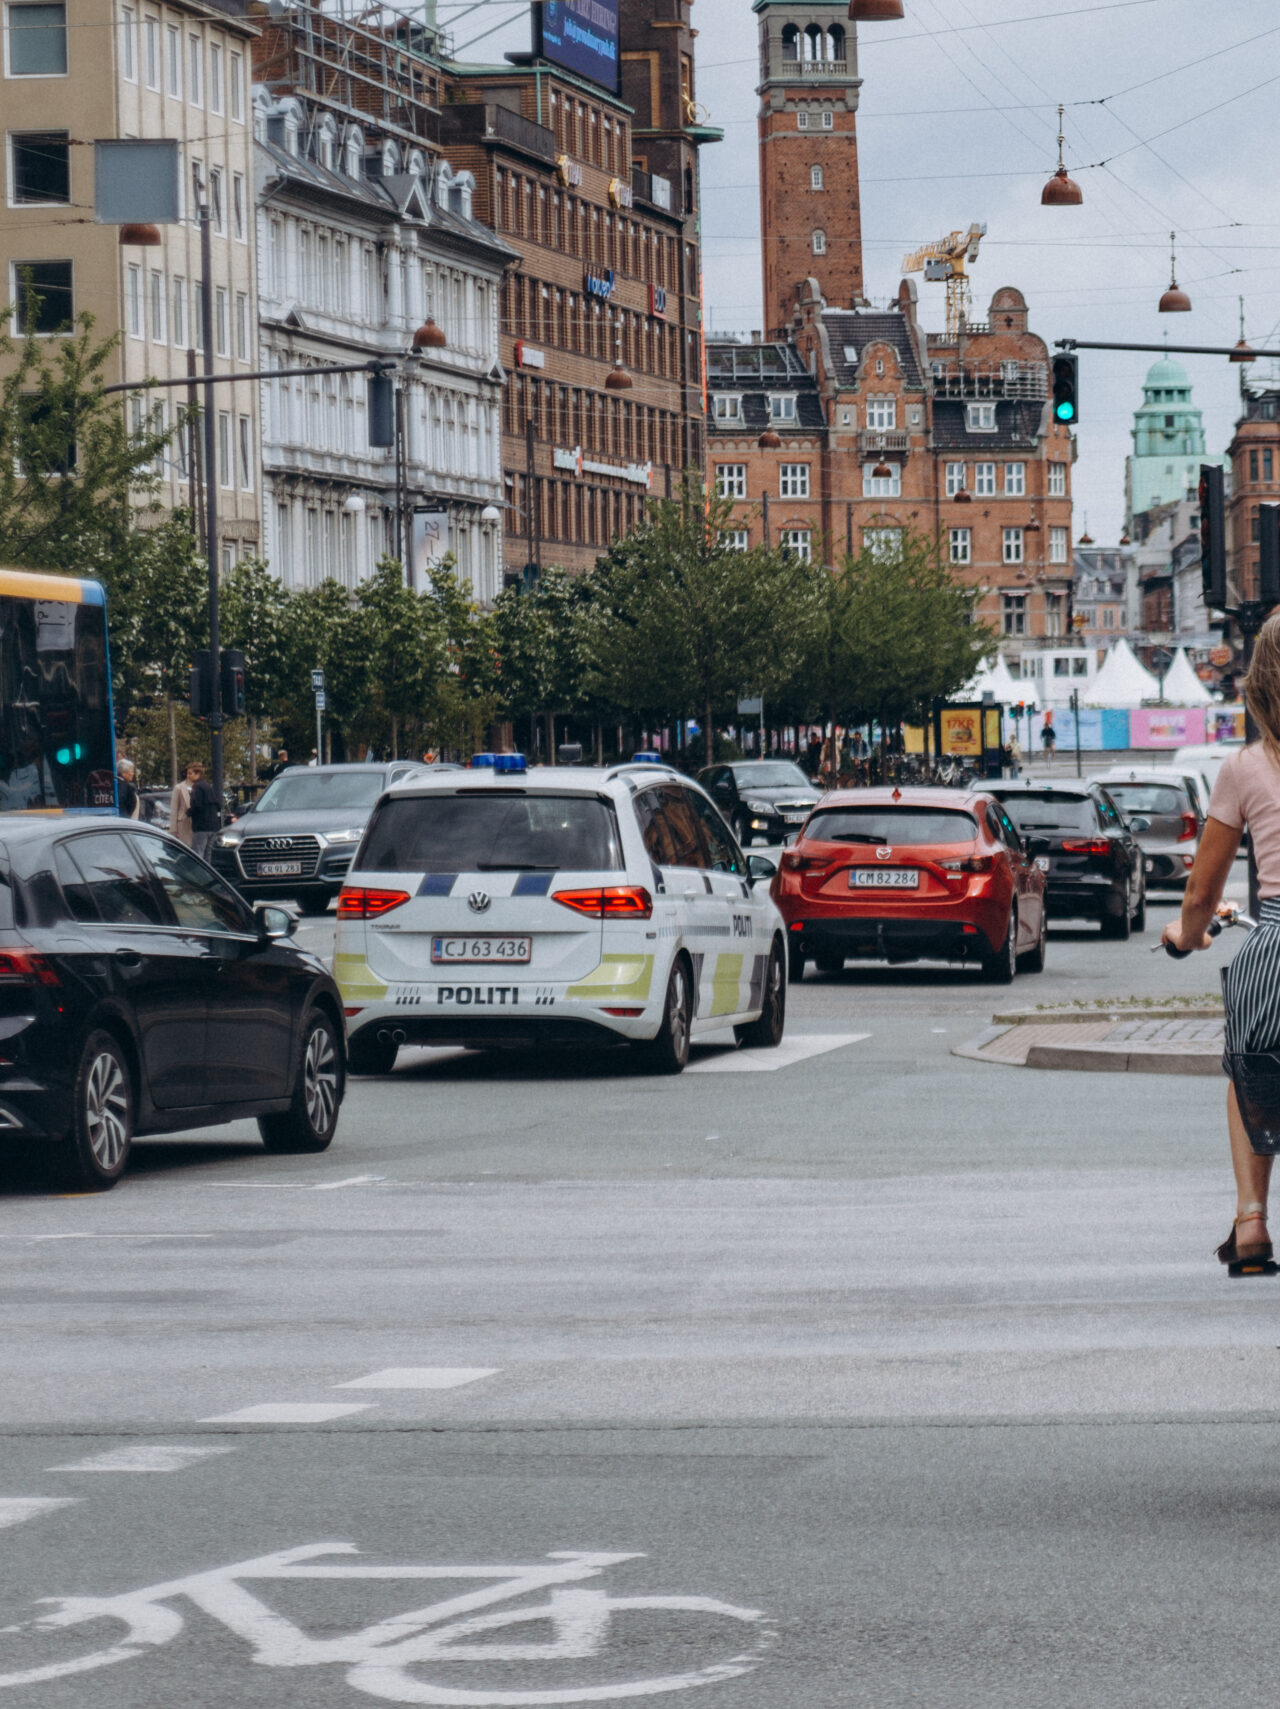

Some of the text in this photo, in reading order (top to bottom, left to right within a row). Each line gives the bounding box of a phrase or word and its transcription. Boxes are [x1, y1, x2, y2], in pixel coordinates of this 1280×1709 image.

[858, 870, 917, 885] CM 82 284
[733, 914, 753, 938] POLITI
[445, 941, 527, 957] CJ 63 436
[437, 986, 519, 1005] POLITI
